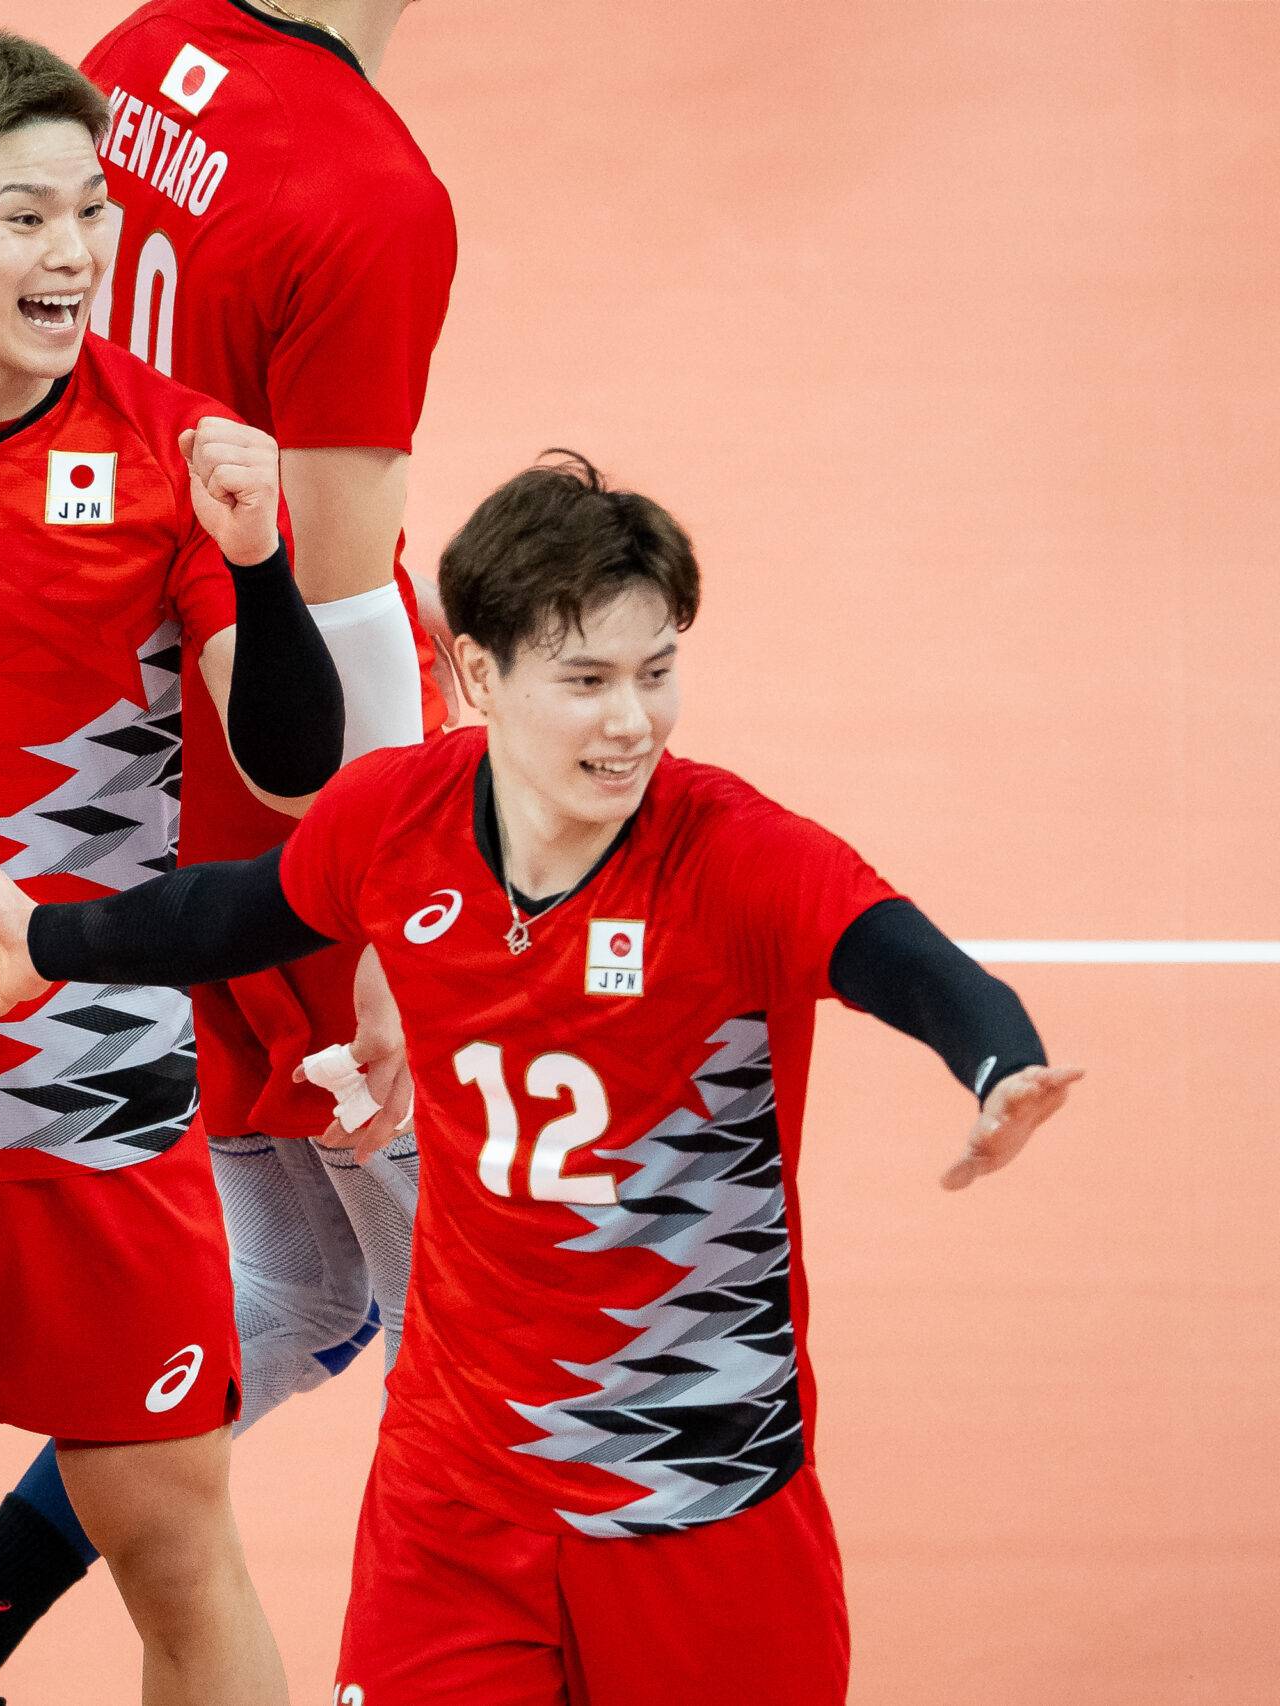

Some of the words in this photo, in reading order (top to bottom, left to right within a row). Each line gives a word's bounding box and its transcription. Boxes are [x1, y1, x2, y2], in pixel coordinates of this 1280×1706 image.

[58, 502, 101, 519] JPN
[598, 972, 636, 990] JPN
[452, 1040, 618, 1207] 12
